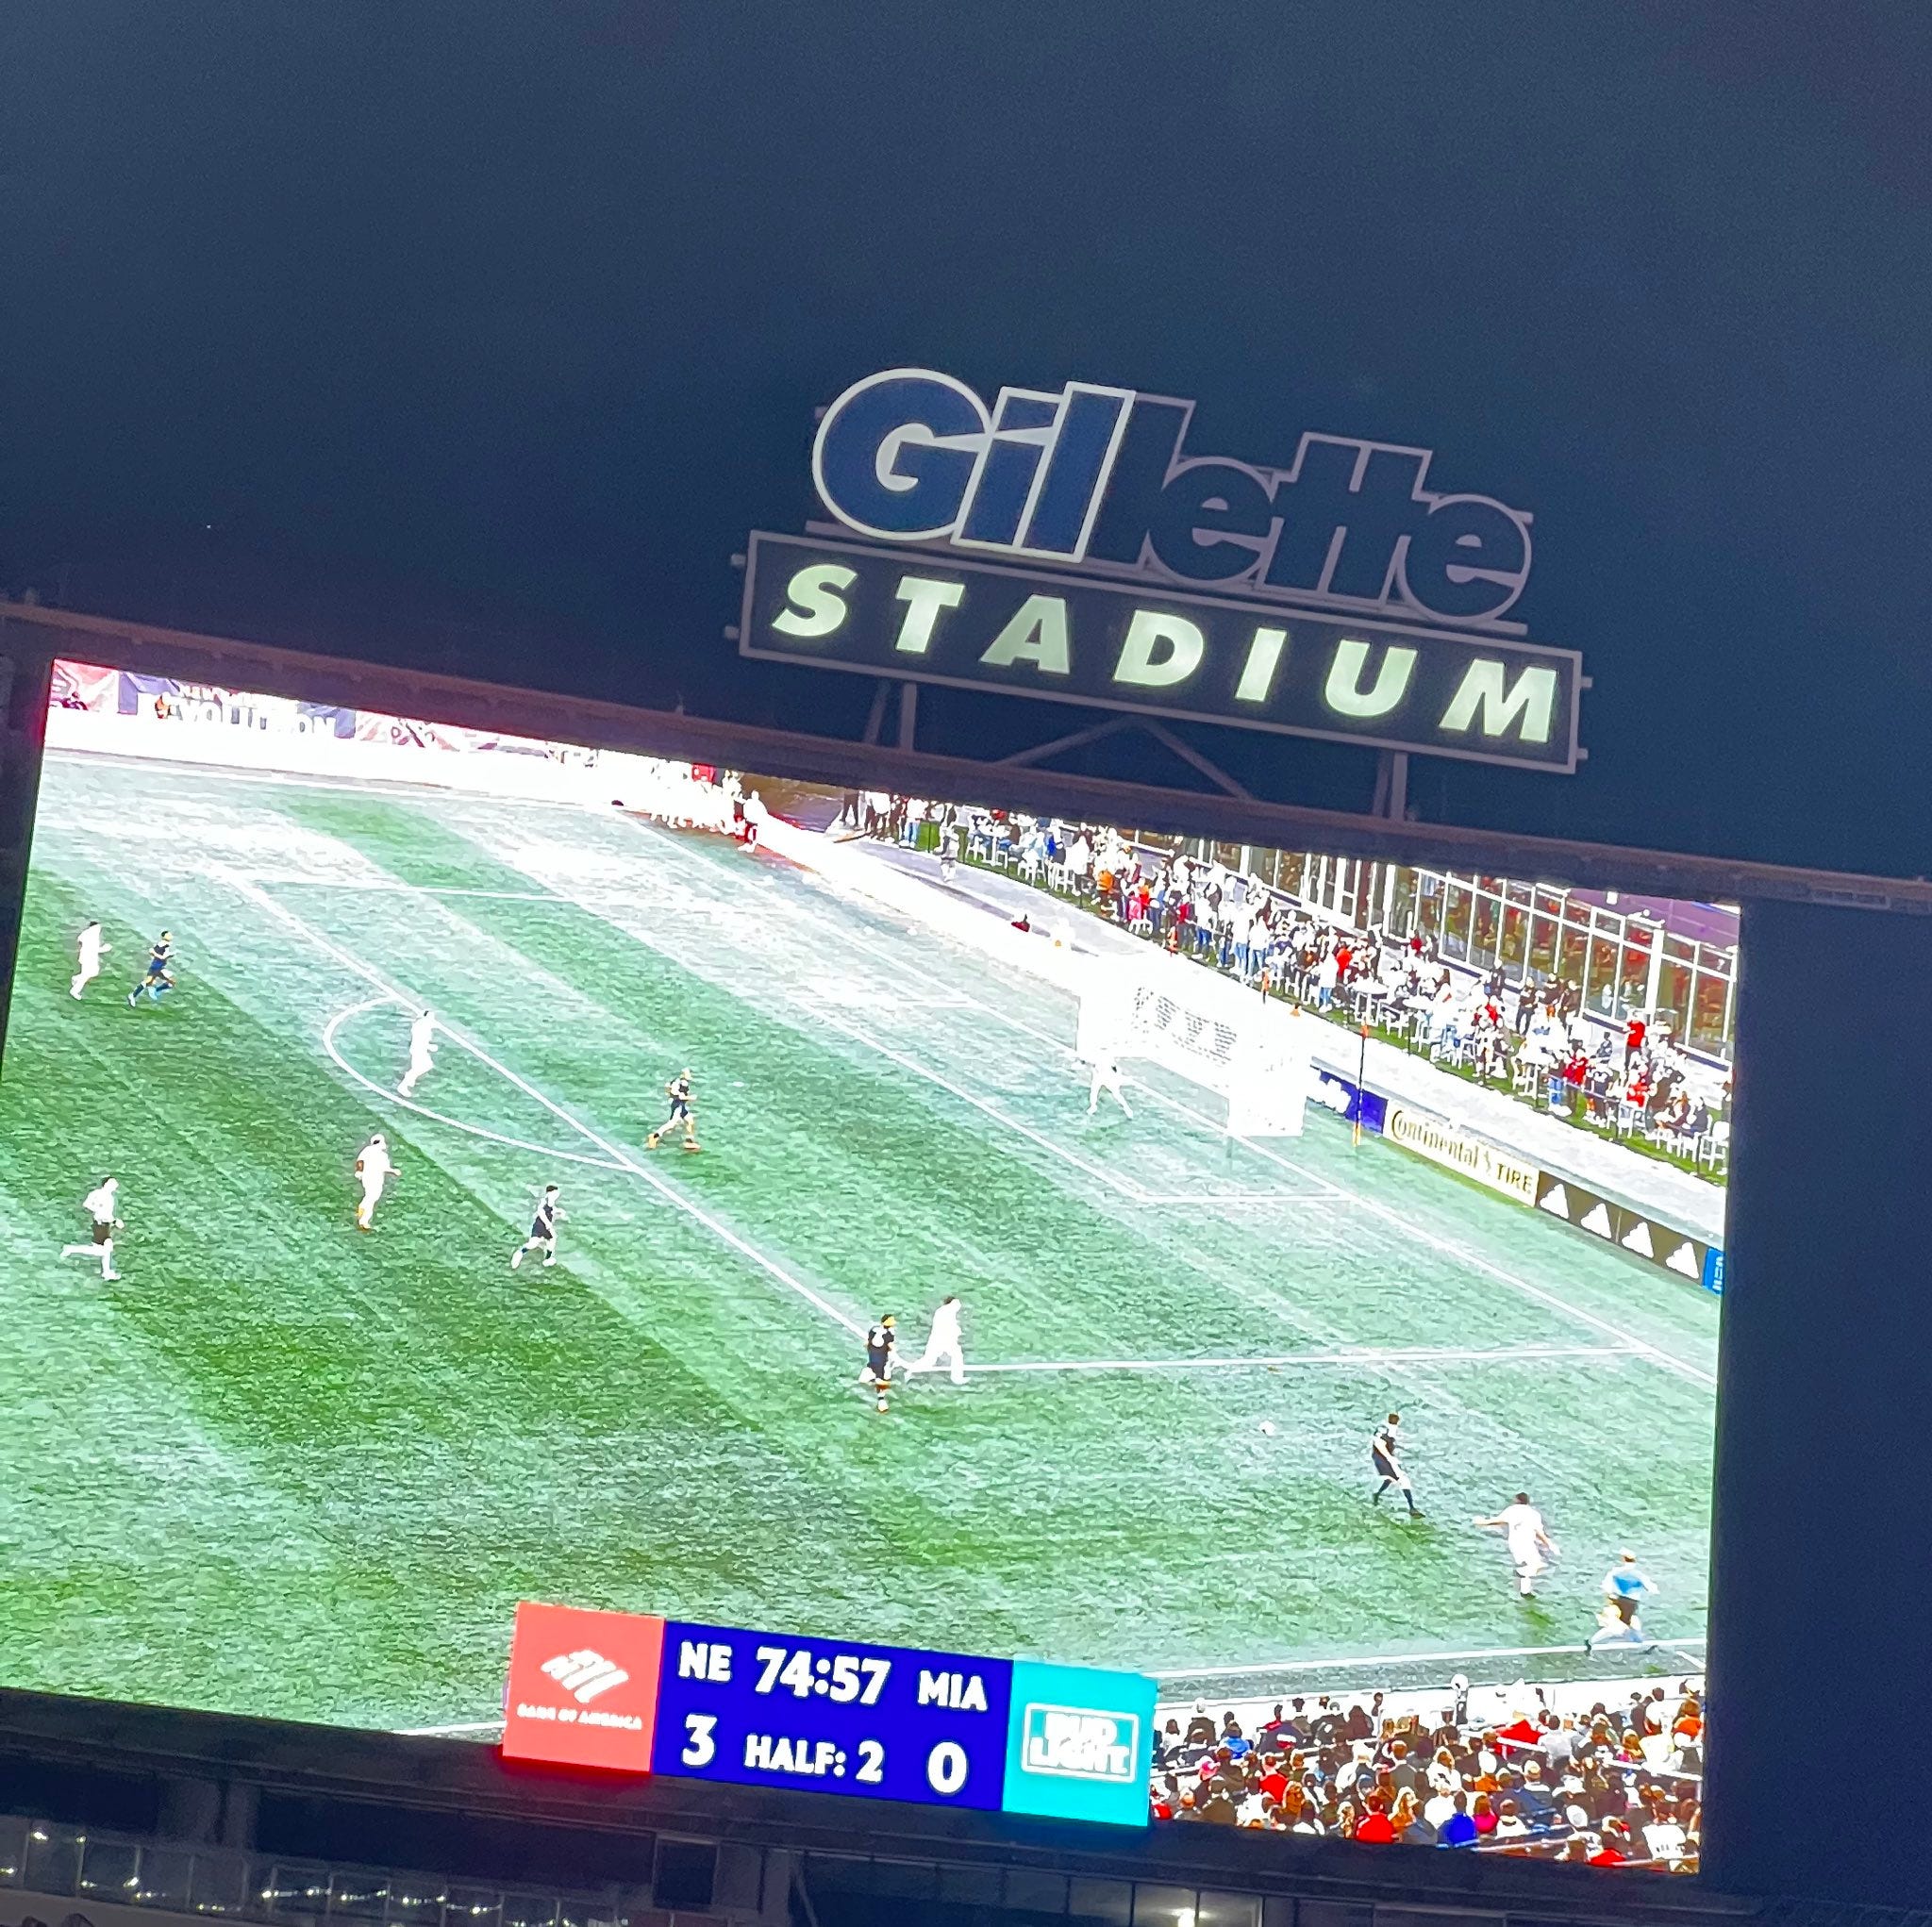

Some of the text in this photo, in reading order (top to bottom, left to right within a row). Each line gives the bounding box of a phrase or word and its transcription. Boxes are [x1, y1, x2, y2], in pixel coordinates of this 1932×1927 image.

[811, 367, 1532, 625] Gillette
[772, 564, 1558, 743] STADIUM
[1391, 1109, 1534, 1194] Continental TIRE
[517, 1703, 642, 1731] BANK OF AMERICA
[678, 1639, 989, 1713] NE 74:57 MIA
[680, 1713, 969, 1796] 3 HALF: 2 0
